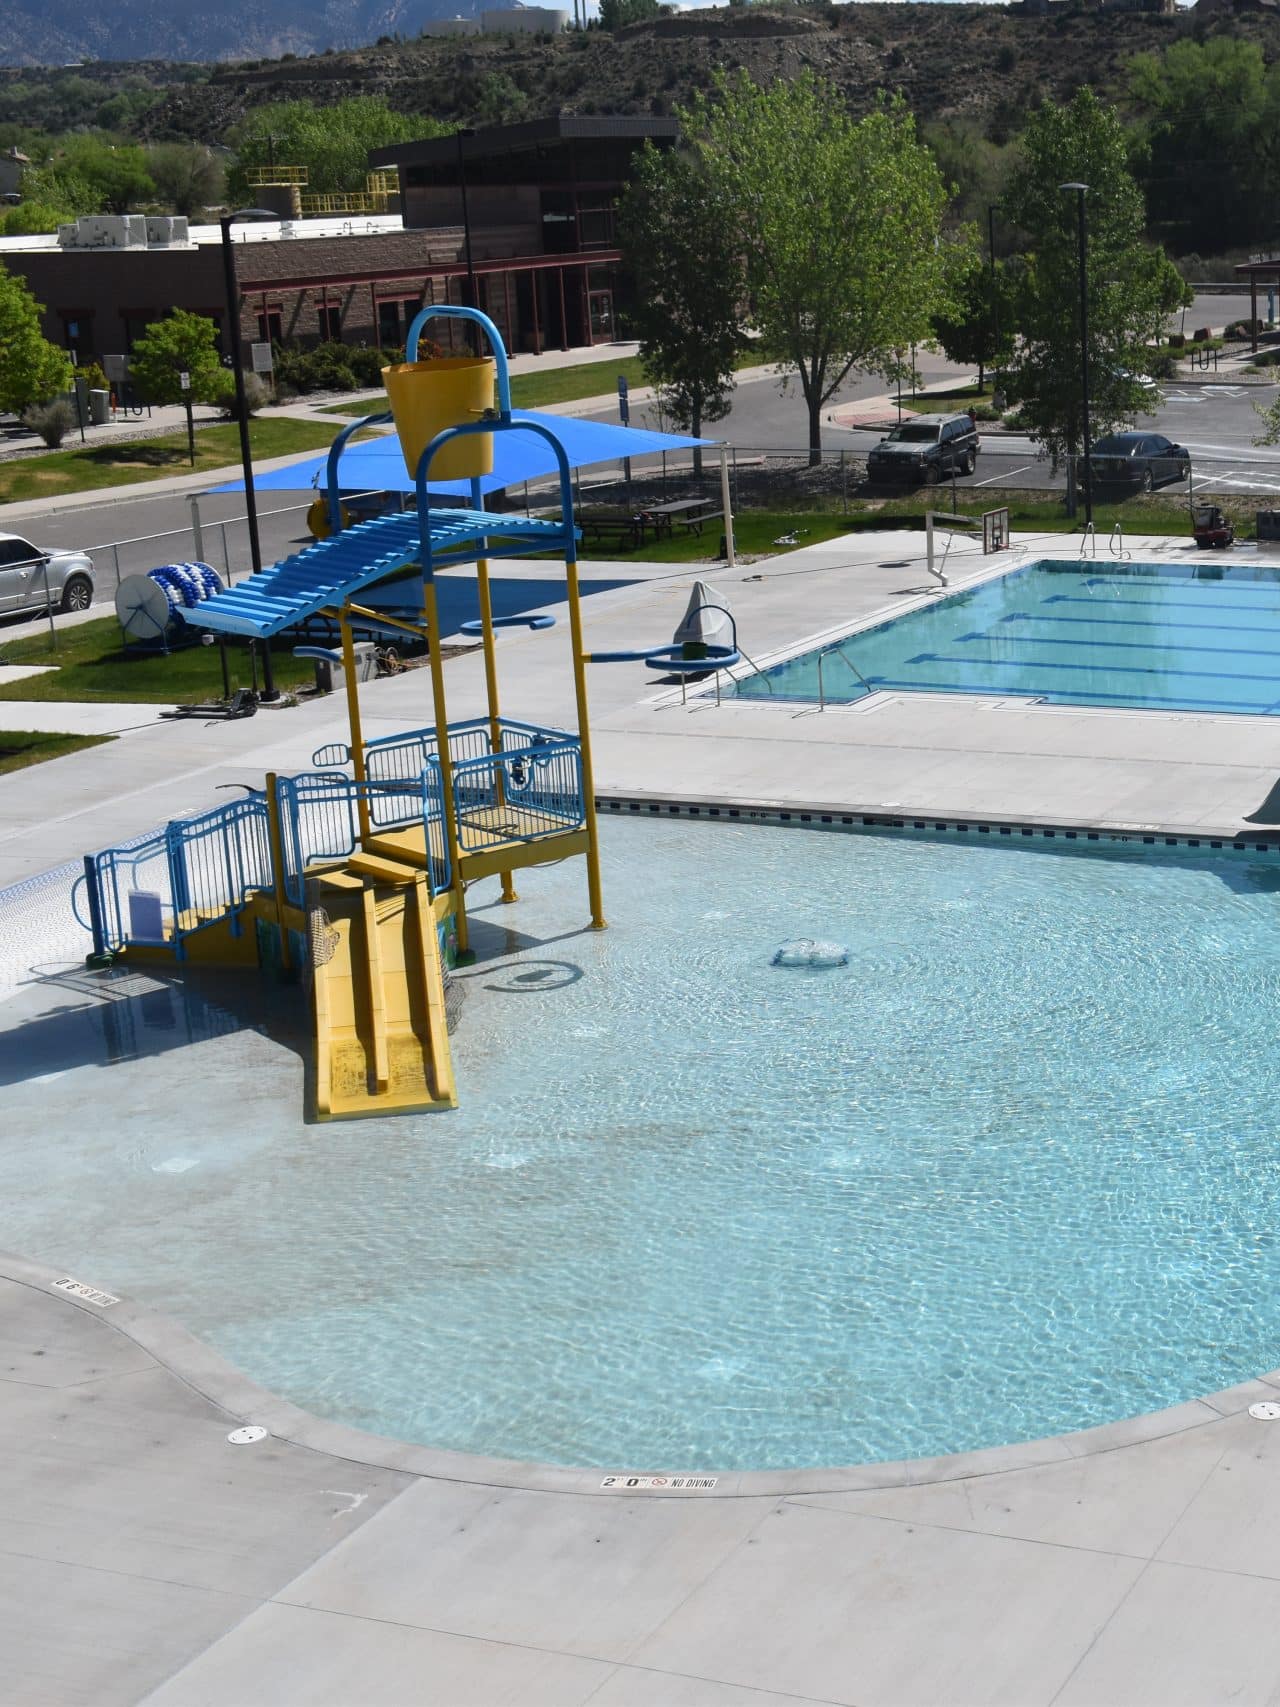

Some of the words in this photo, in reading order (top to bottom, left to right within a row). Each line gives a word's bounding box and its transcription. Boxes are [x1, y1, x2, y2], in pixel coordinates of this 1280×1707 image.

[603, 1477, 616, 1487] 2
[626, 1478, 639, 1487] 0
[670, 1478, 685, 1488] NO
[686, 1479, 716, 1488] DIVING
